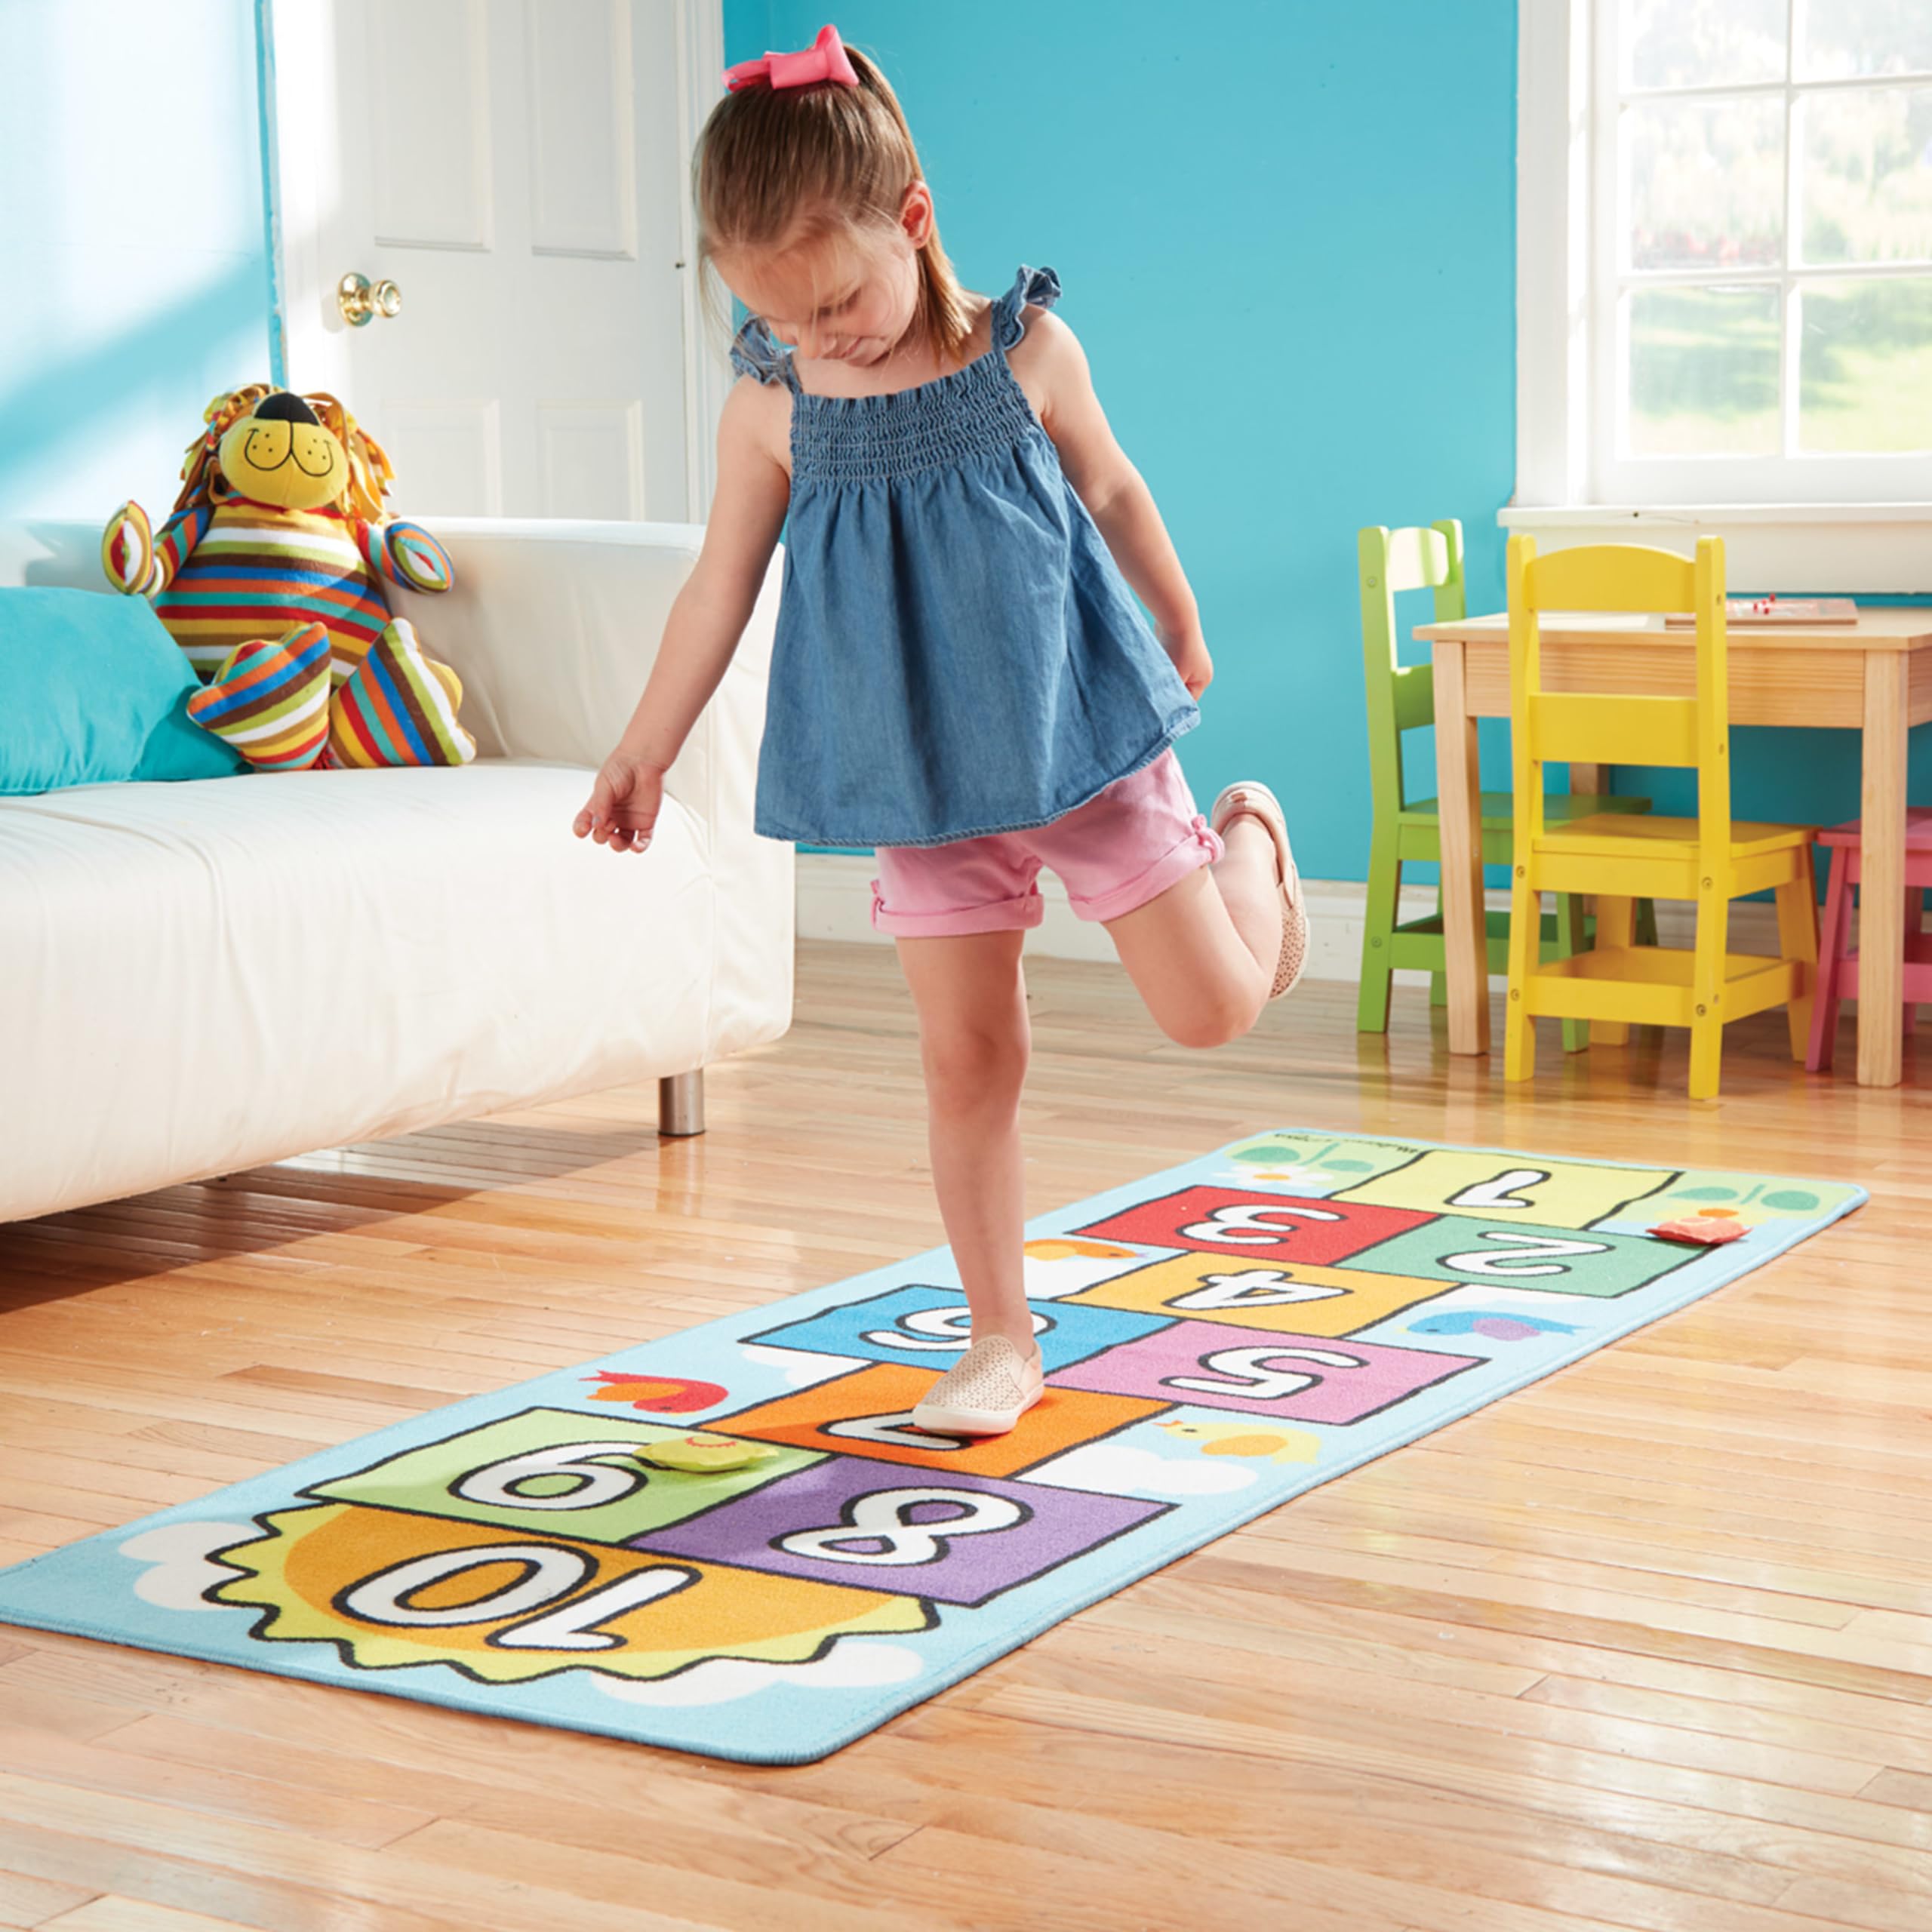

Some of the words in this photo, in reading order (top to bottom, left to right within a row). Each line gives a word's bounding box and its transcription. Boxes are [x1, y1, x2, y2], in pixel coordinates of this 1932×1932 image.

[1446, 1169, 1551, 1208] 1
[1177, 1204, 1347, 1245] 3
[1437, 1230, 1615, 1277] 2
[1164, 1269, 1353, 1310] 4
[1160, 1345, 1369, 1400] 5
[768, 1486, 1034, 1566] 8
[331, 1541, 703, 1652] 10
